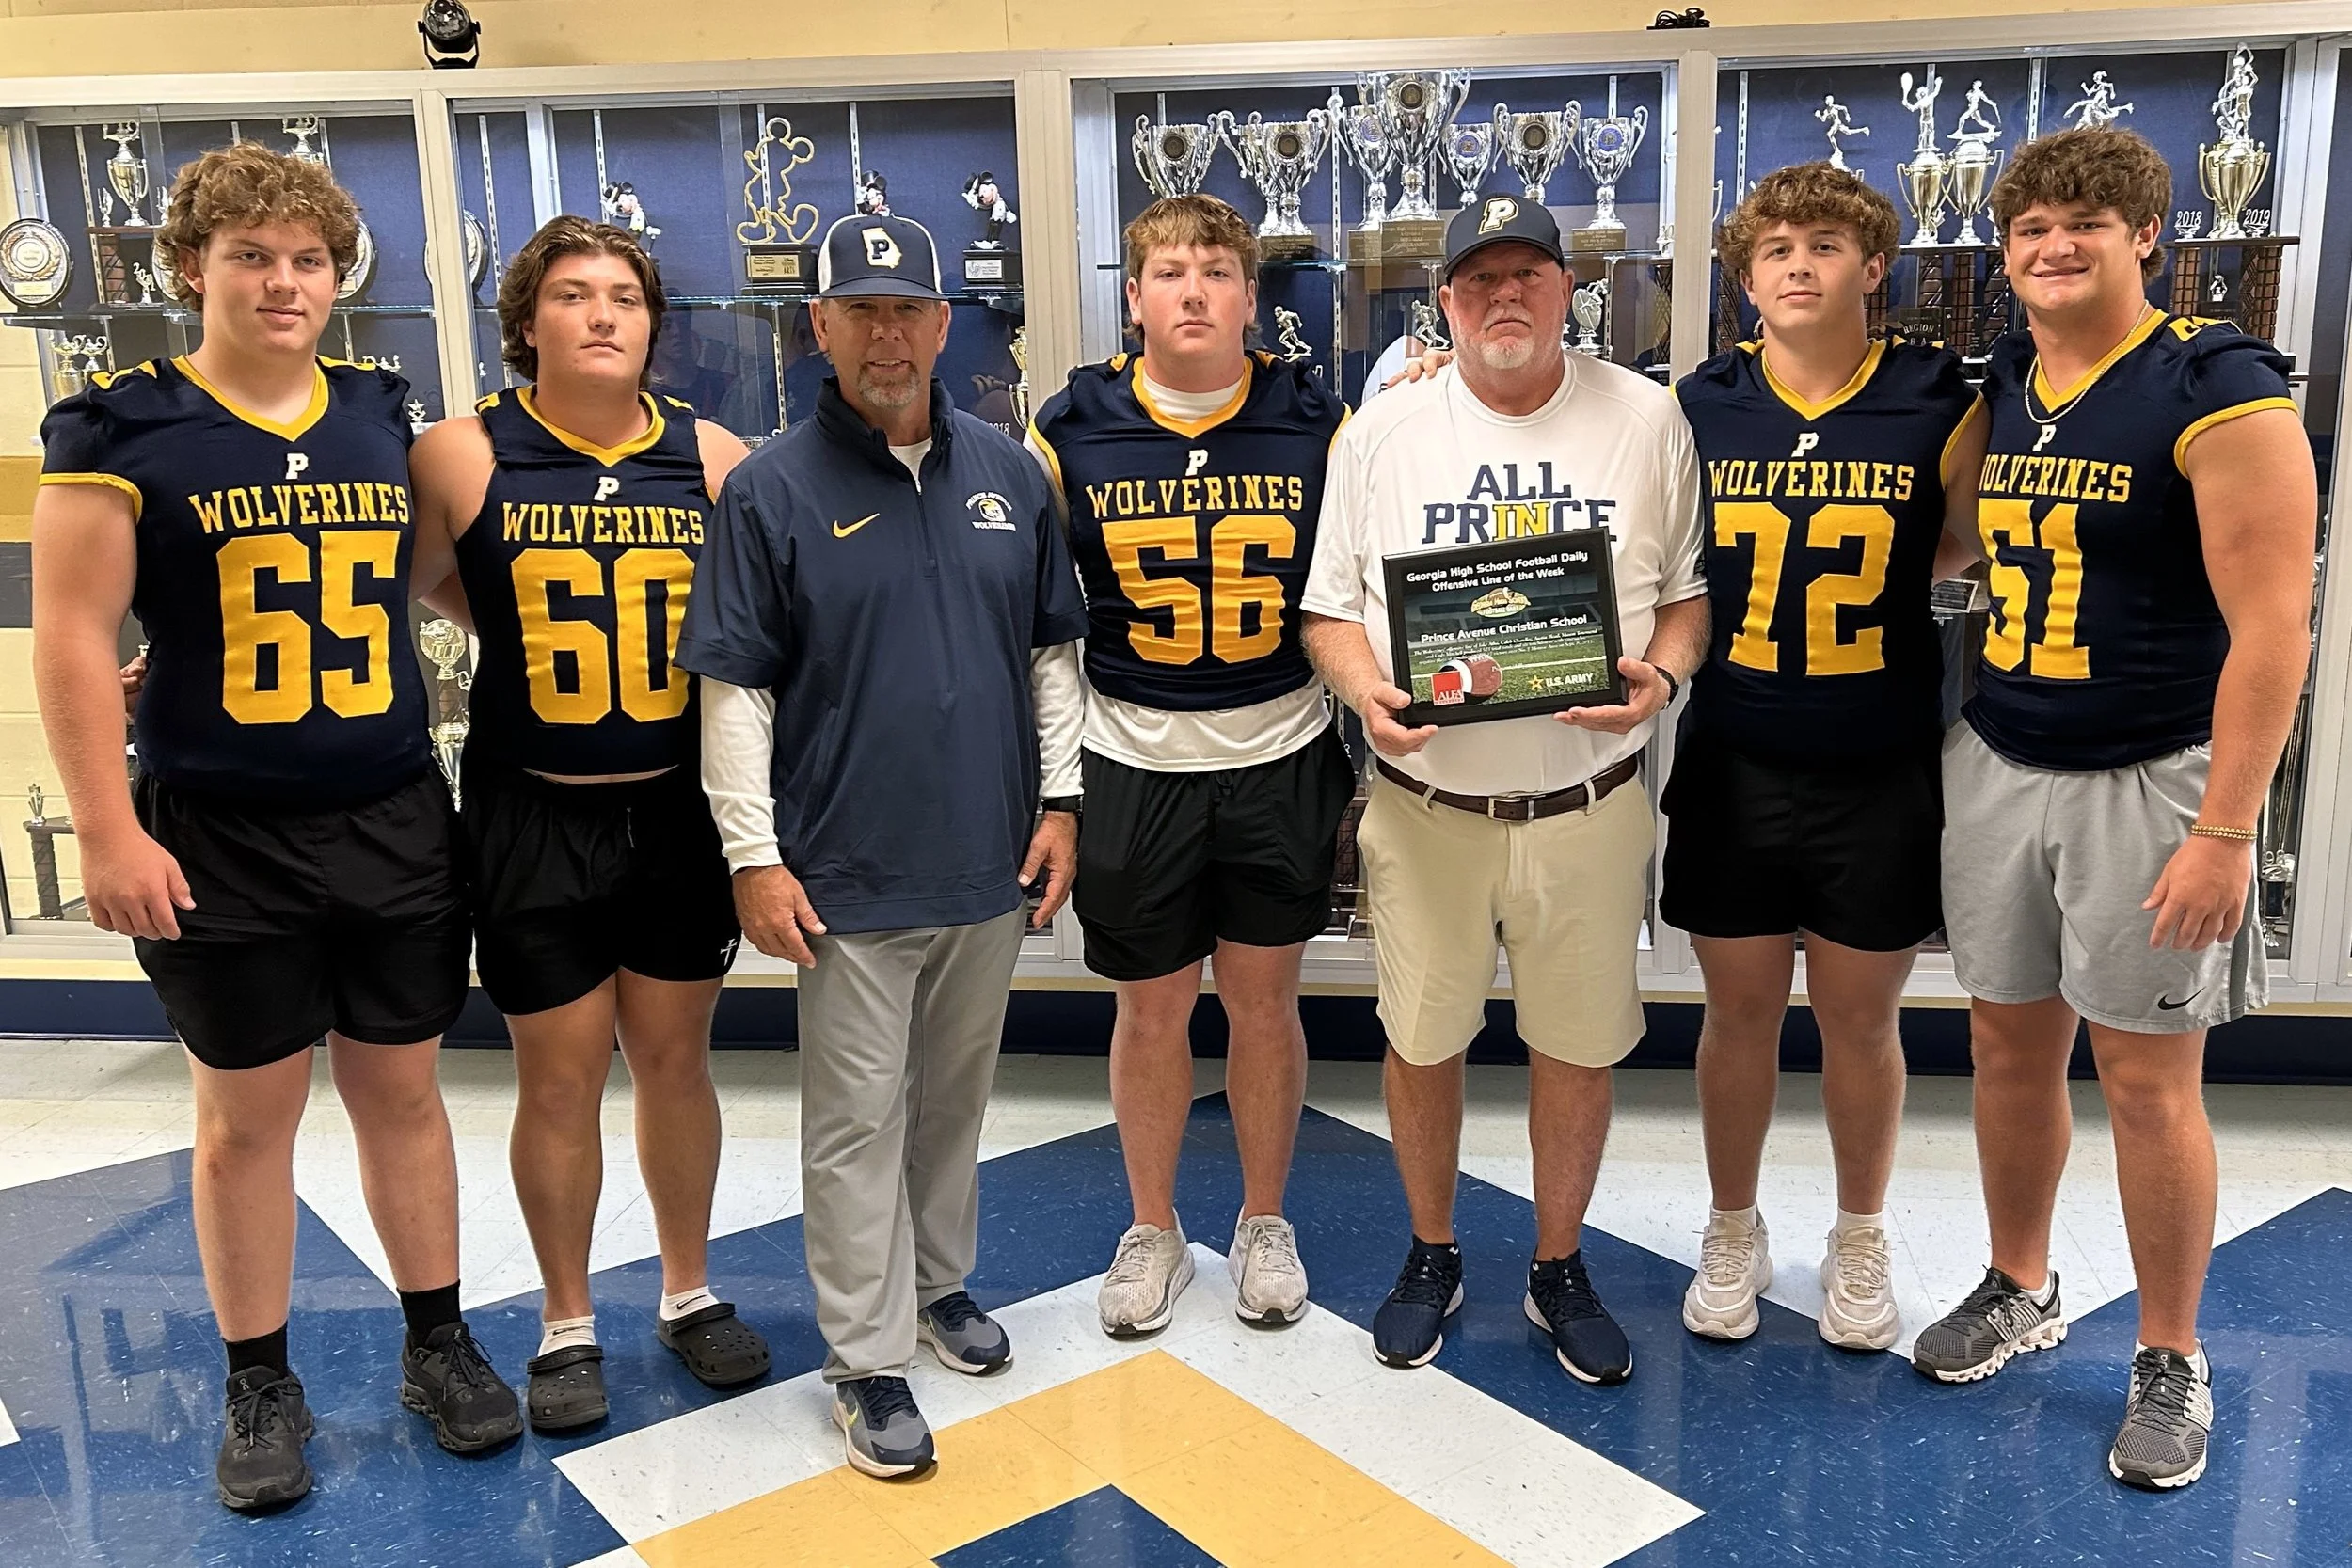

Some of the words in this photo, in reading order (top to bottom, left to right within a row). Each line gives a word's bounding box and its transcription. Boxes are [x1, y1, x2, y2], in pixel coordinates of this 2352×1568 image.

[1478, 197, 1519, 235] P
[2176, 211, 2202, 226] 2018
[2243, 209, 2271, 226] 2019
[871, 239, 889, 259] P
[1791, 432, 1820, 458] P
[2032, 425, 2057, 452] P
[285, 452, 310, 480] P
[1184, 449, 1209, 477] P
[1708, 459, 1915, 501] WOLVERINES
[593, 476, 620, 501] P
[1086, 475, 1303, 518] WOLVERINES
[1467, 462, 1571, 501] ALL
[188, 483, 409, 533] WOLVERINES
[502, 502, 705, 545] WOLVERINES
[1422, 499, 1617, 544] PRINCE
[1407, 569, 1447, 582] Georgia
[1450, 565, 1474, 578] High
[1476, 561, 1512, 573] School
[1515, 555, 1558, 568] Football
[1561, 551, 1588, 562] Daily
[1432, 578, 1479, 592] Offensive
[1481, 575, 1502, 585] Line
[1504, 573, 1515, 583] of
[1518, 570, 1534, 581] the
[1536, 566, 1565, 578] Week
[1102, 515, 1297, 665] 56
[1714, 501, 1895, 675] 72
[1978, 498, 2091, 679] 51
[215, 530, 401, 724] 65
[511, 548, 695, 724] 60
[1421, 633, 1455, 644] Prince
[1457, 628, 1497, 640] Avenue
[1499, 622, 1548, 634] Christian
[1549, 614, 1588, 627] School
[1546, 677, 1564, 688] U.S.
[1565, 673, 1594, 685] ARMY
